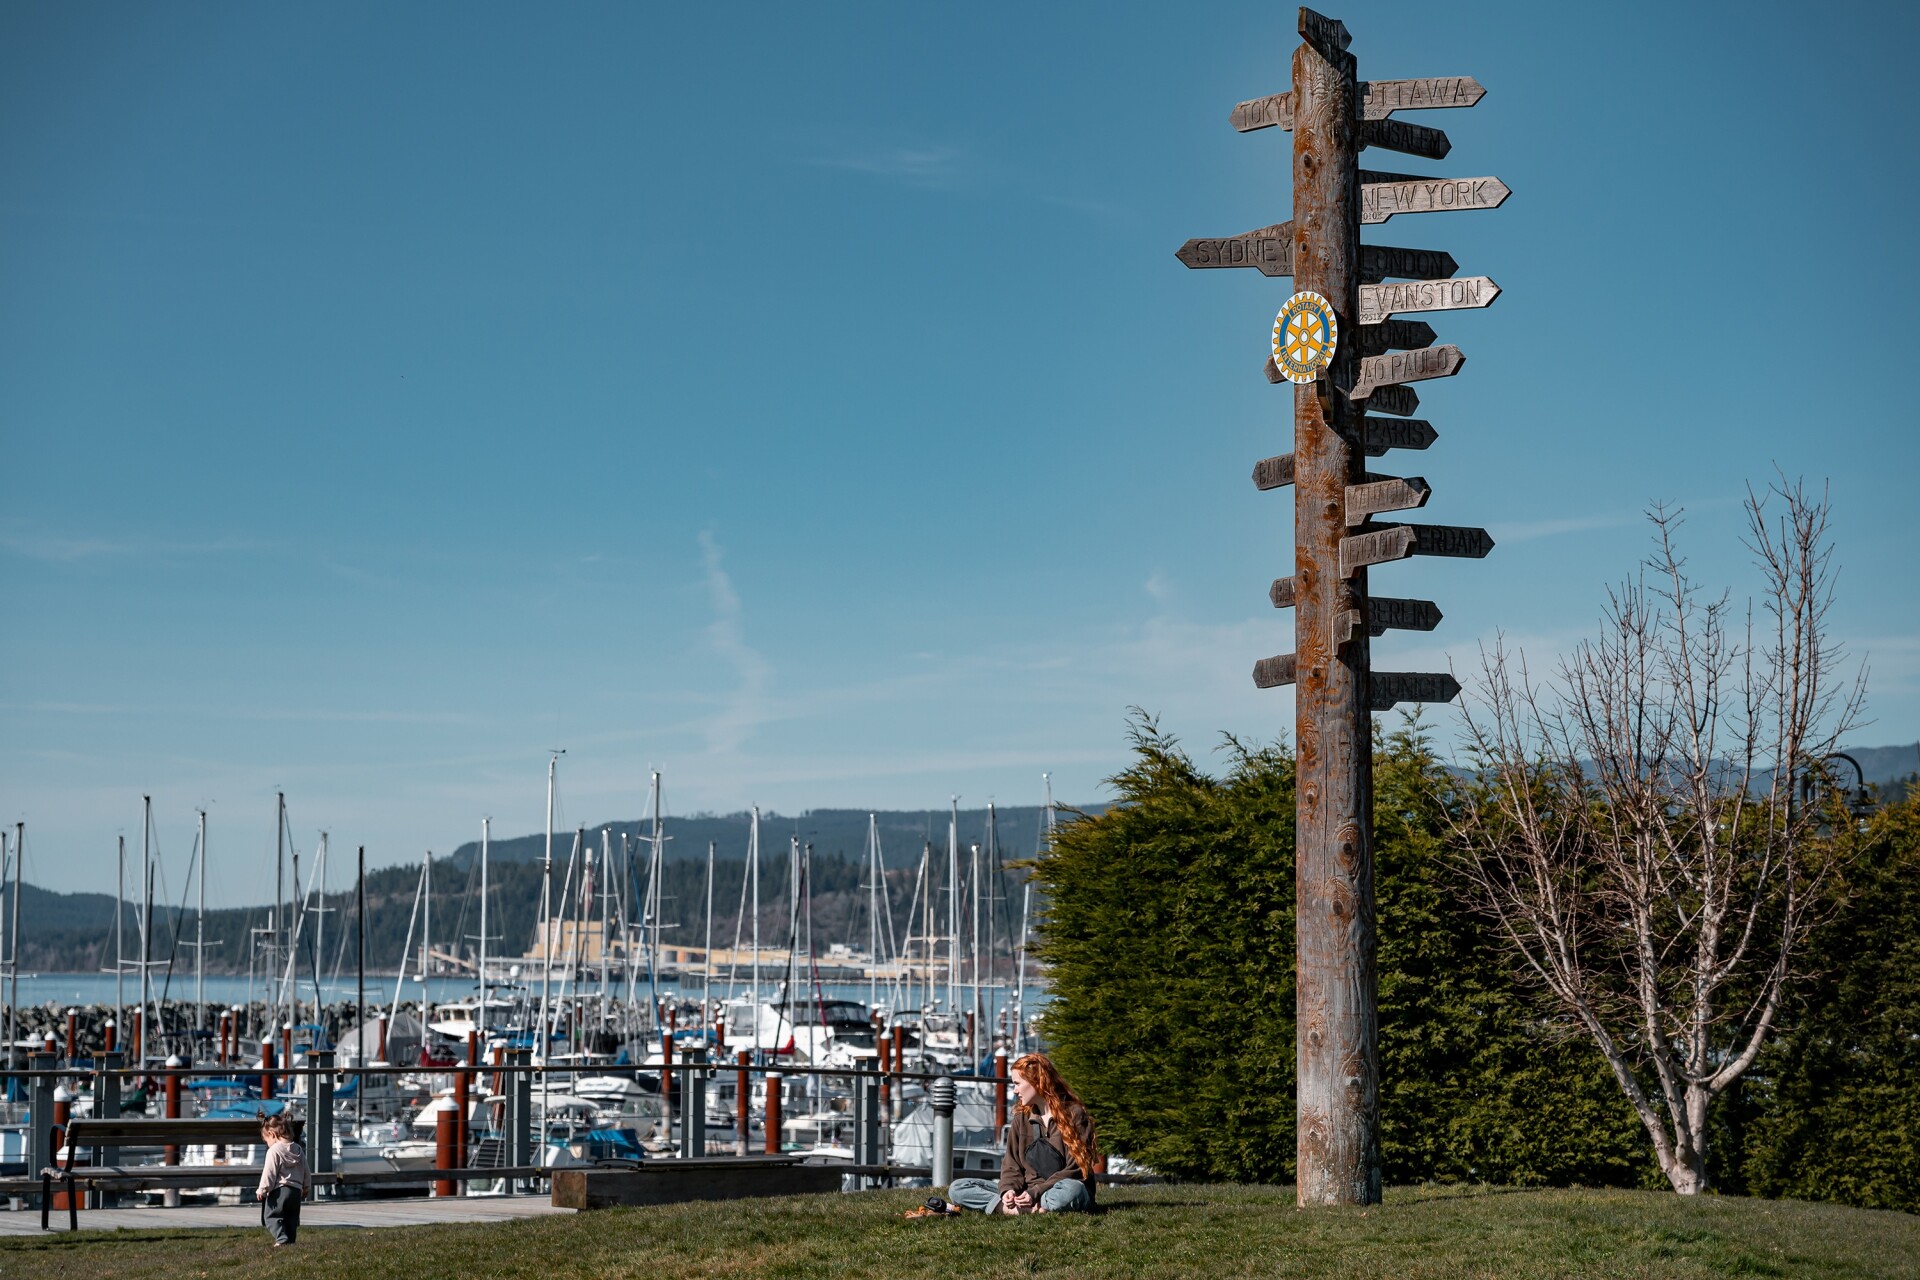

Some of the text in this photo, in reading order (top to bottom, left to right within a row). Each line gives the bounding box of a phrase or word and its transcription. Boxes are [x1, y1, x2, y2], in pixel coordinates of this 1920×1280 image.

[1360, 78, 1468, 106] OTTAWA
[1361, 180, 1488, 212] NEW YORK
[1196, 238, 1293, 264] SYDNEY
[1361, 247, 1443, 277] LONDON
[1292, 302, 1318, 315] ROTARY
[1360, 280, 1481, 312] EVANSTON
[1362, 321, 1420, 345] ROME
[1281, 348, 1328, 373] INTERNATIONAL
[1359, 347, 1448, 385] AO PAULO
[1366, 419, 1425, 445] PARIS
[1341, 530, 1400, 566] MEXICO CITY
[1418, 527, 1483, 555] ERDAM
[1368, 600, 1429, 626] BERLIN
[1371, 676, 1444, 700] MUNICH
